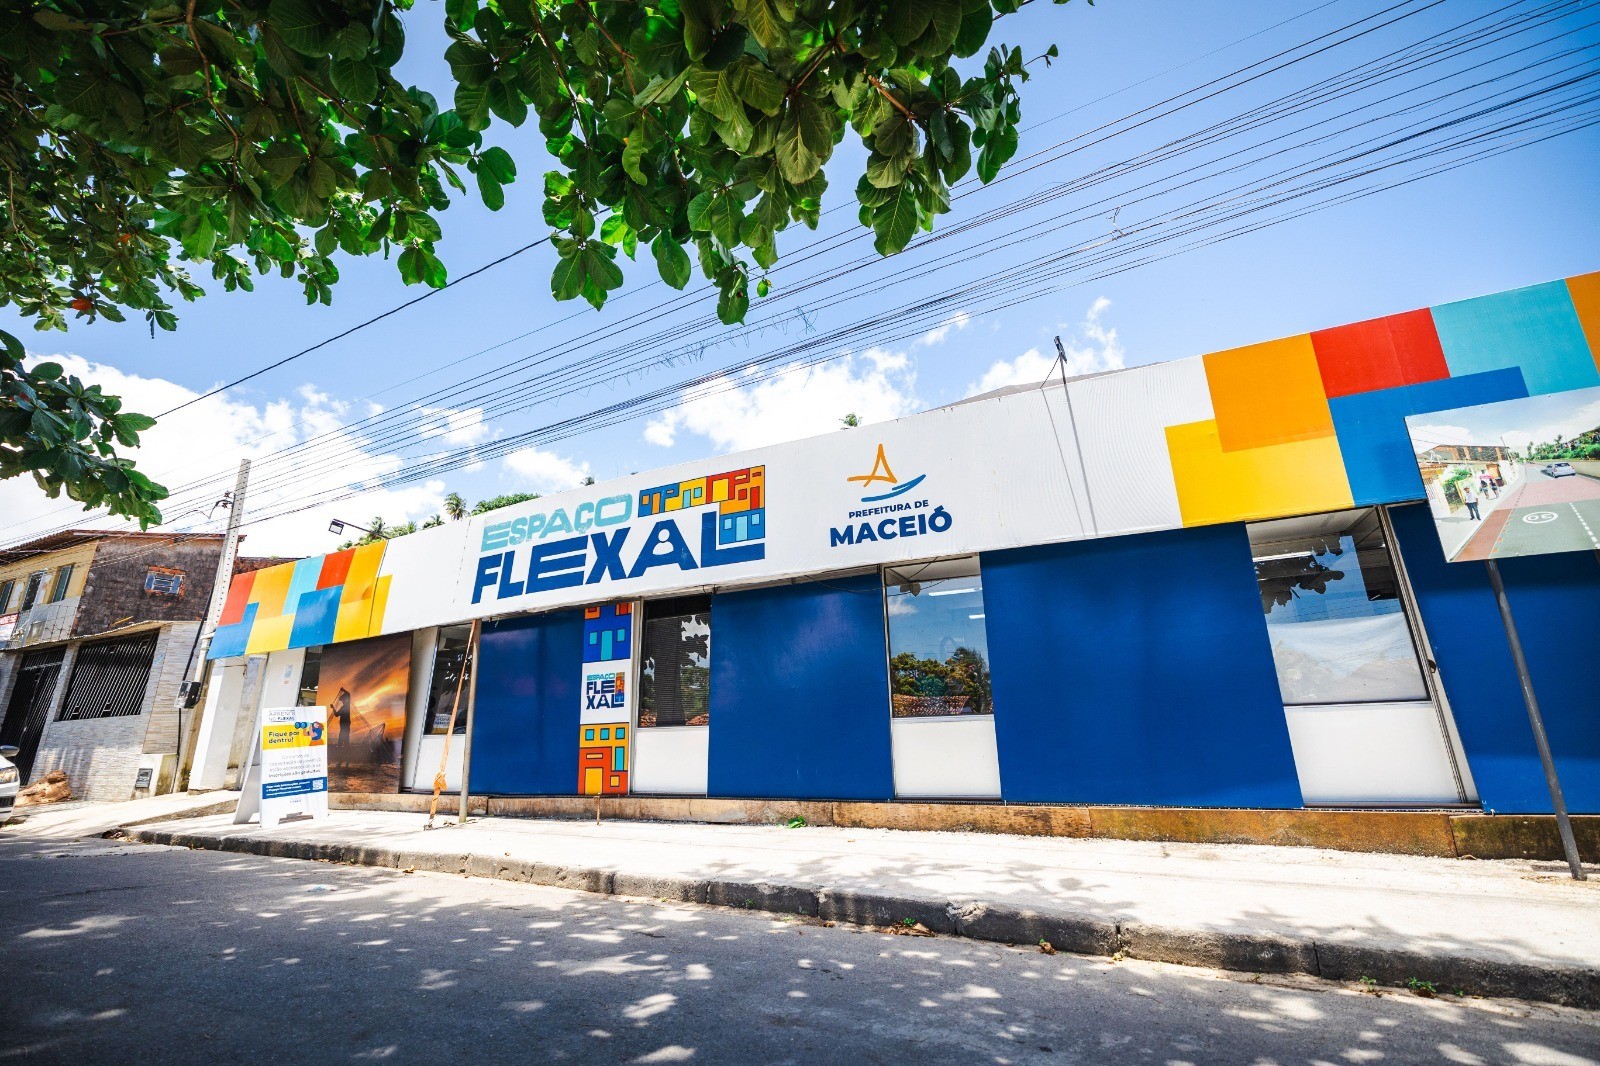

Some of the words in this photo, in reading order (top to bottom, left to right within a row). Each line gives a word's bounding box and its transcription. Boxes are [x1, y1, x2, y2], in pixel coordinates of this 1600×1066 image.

[480, 493, 634, 552] ESPAÇO
[848, 504, 912, 519] PREFEITURA
[914, 499, 930, 509] DE
[829, 504, 953, 548] MACEIÓ
[471, 511, 766, 605] FLEXAL
[586, 672, 616, 682] ESPAÇO
[268, 736, 294, 744] dentro!
